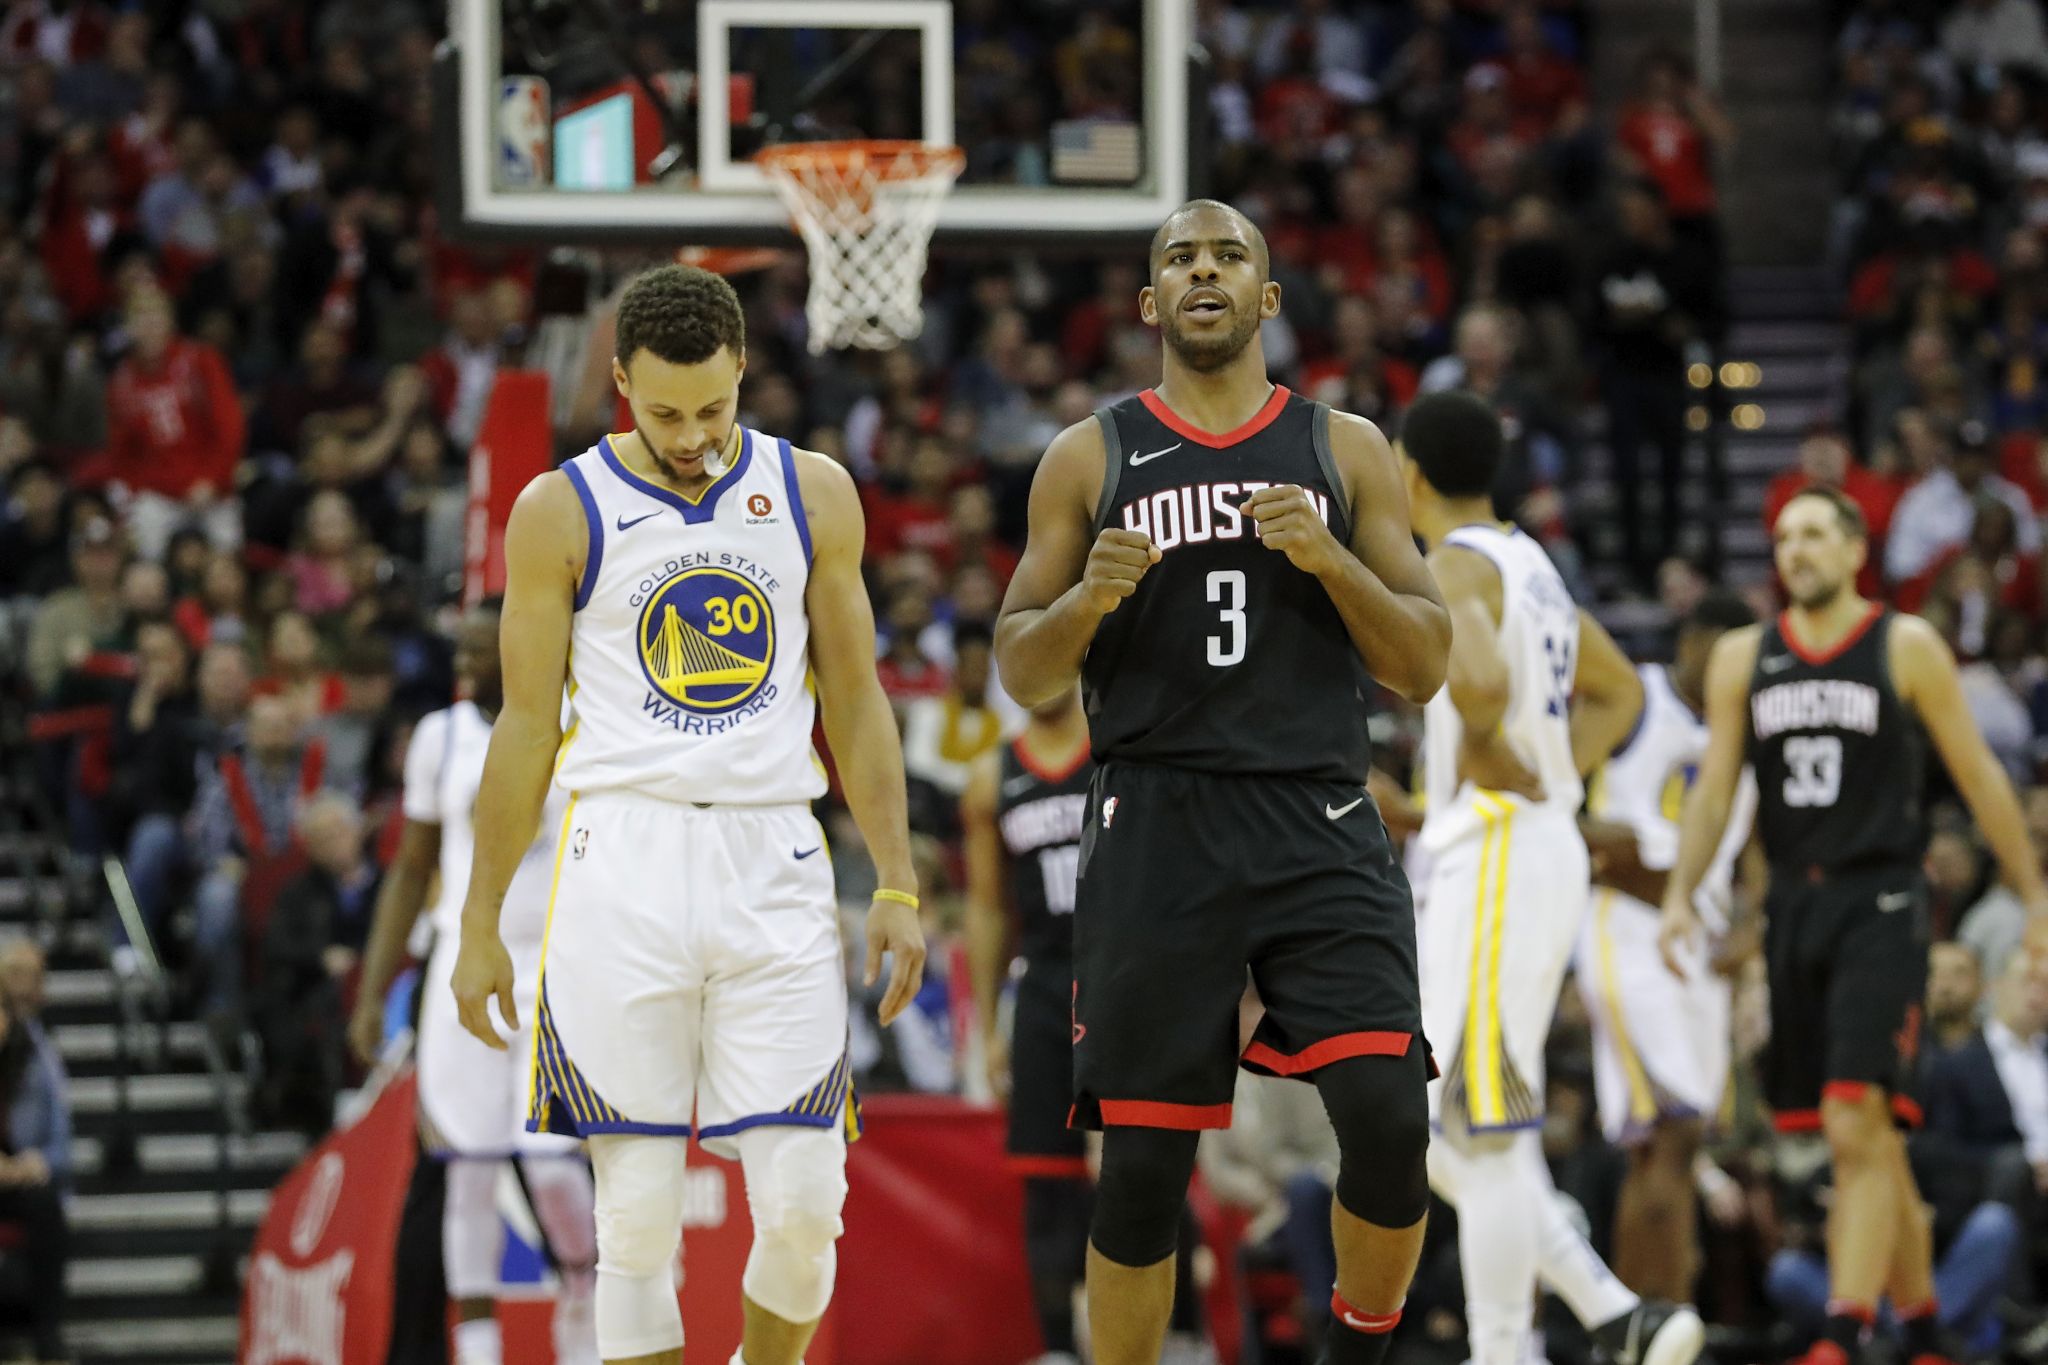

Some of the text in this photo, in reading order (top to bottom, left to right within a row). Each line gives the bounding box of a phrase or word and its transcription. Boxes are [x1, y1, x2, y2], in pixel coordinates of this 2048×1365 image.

[745, 517, 780, 525] Rakuten
[1122, 481, 1329, 552] HOUSTN
[629, 551, 781, 608] GOLDEN STATE
[703, 593, 760, 637] 30
[1206, 569, 1247, 667] 3
[640, 680, 779, 736] WARRIORS
[1750, 678, 1880, 741] HOUSTON
[1782, 734, 1843, 808] 33
